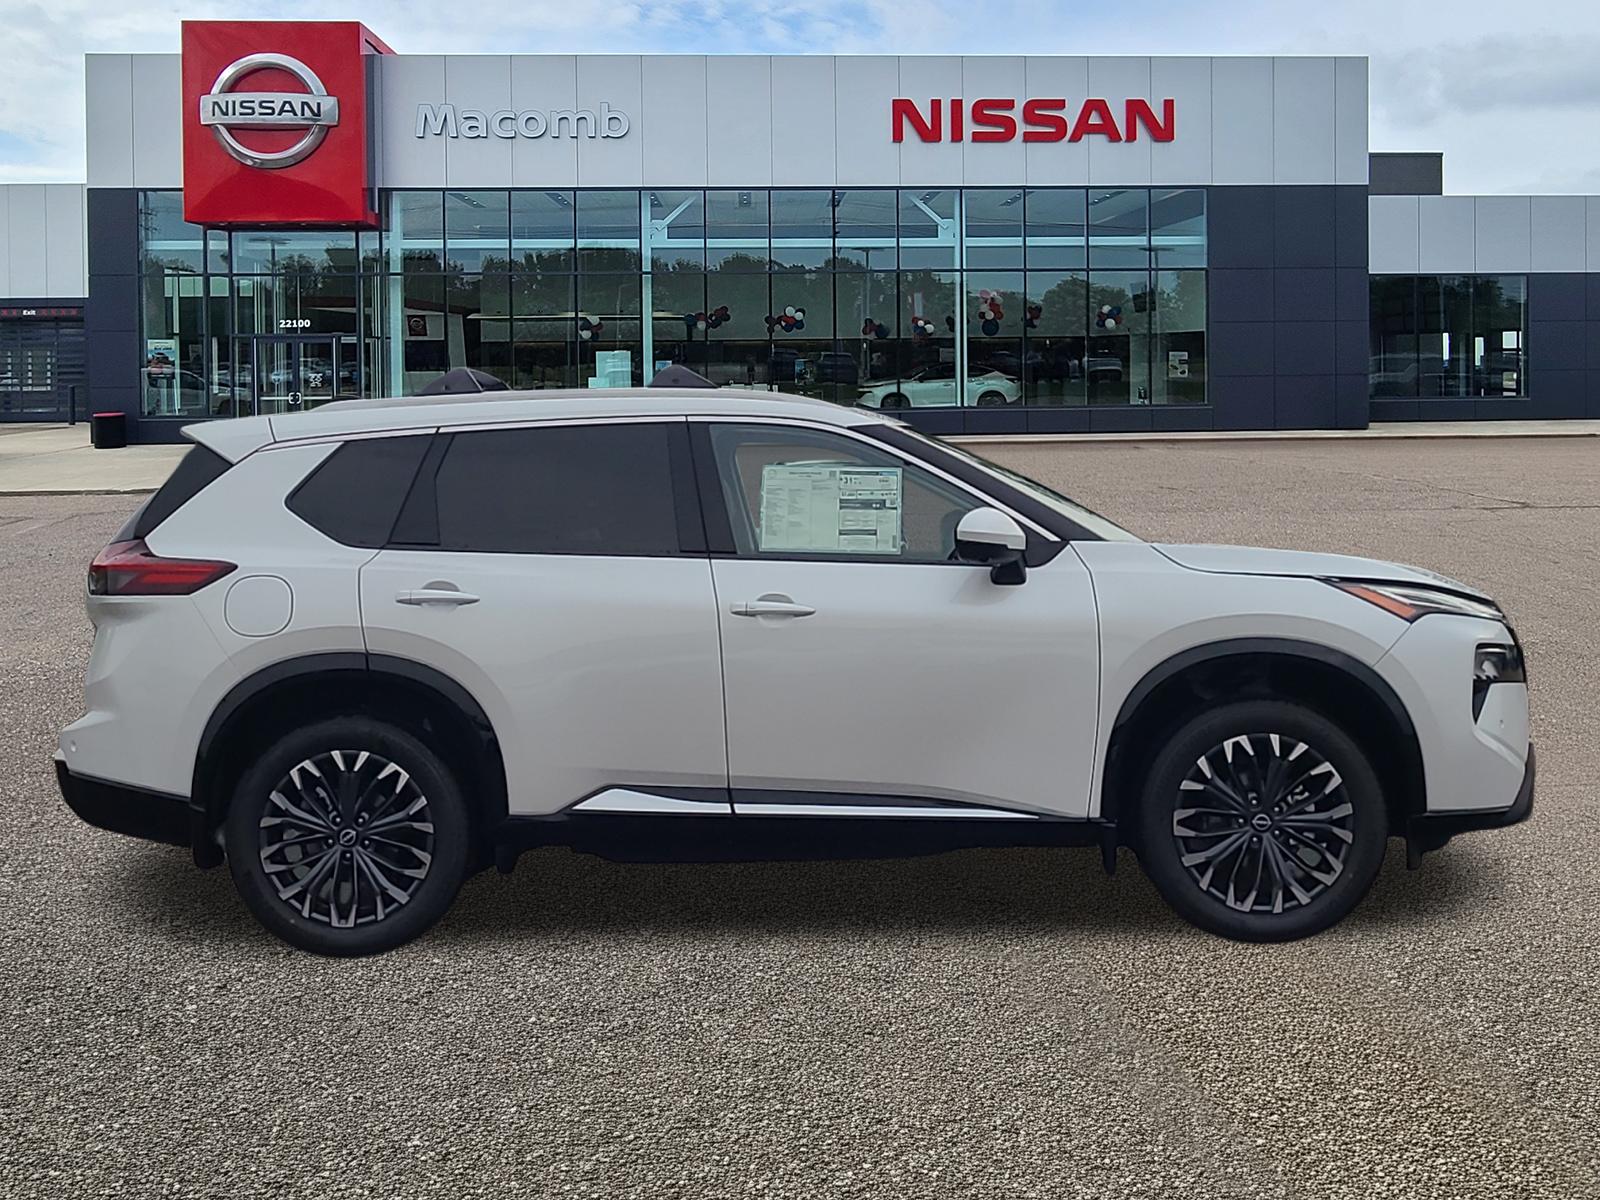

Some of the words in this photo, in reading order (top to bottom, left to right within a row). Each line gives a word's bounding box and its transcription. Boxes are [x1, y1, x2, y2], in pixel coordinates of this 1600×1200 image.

[211, 100, 322, 117] NISSAN
[415, 102, 630, 138] Macomb
[892, 98, 1175, 143] NISSAN
[279, 319, 311, 328] 22100
